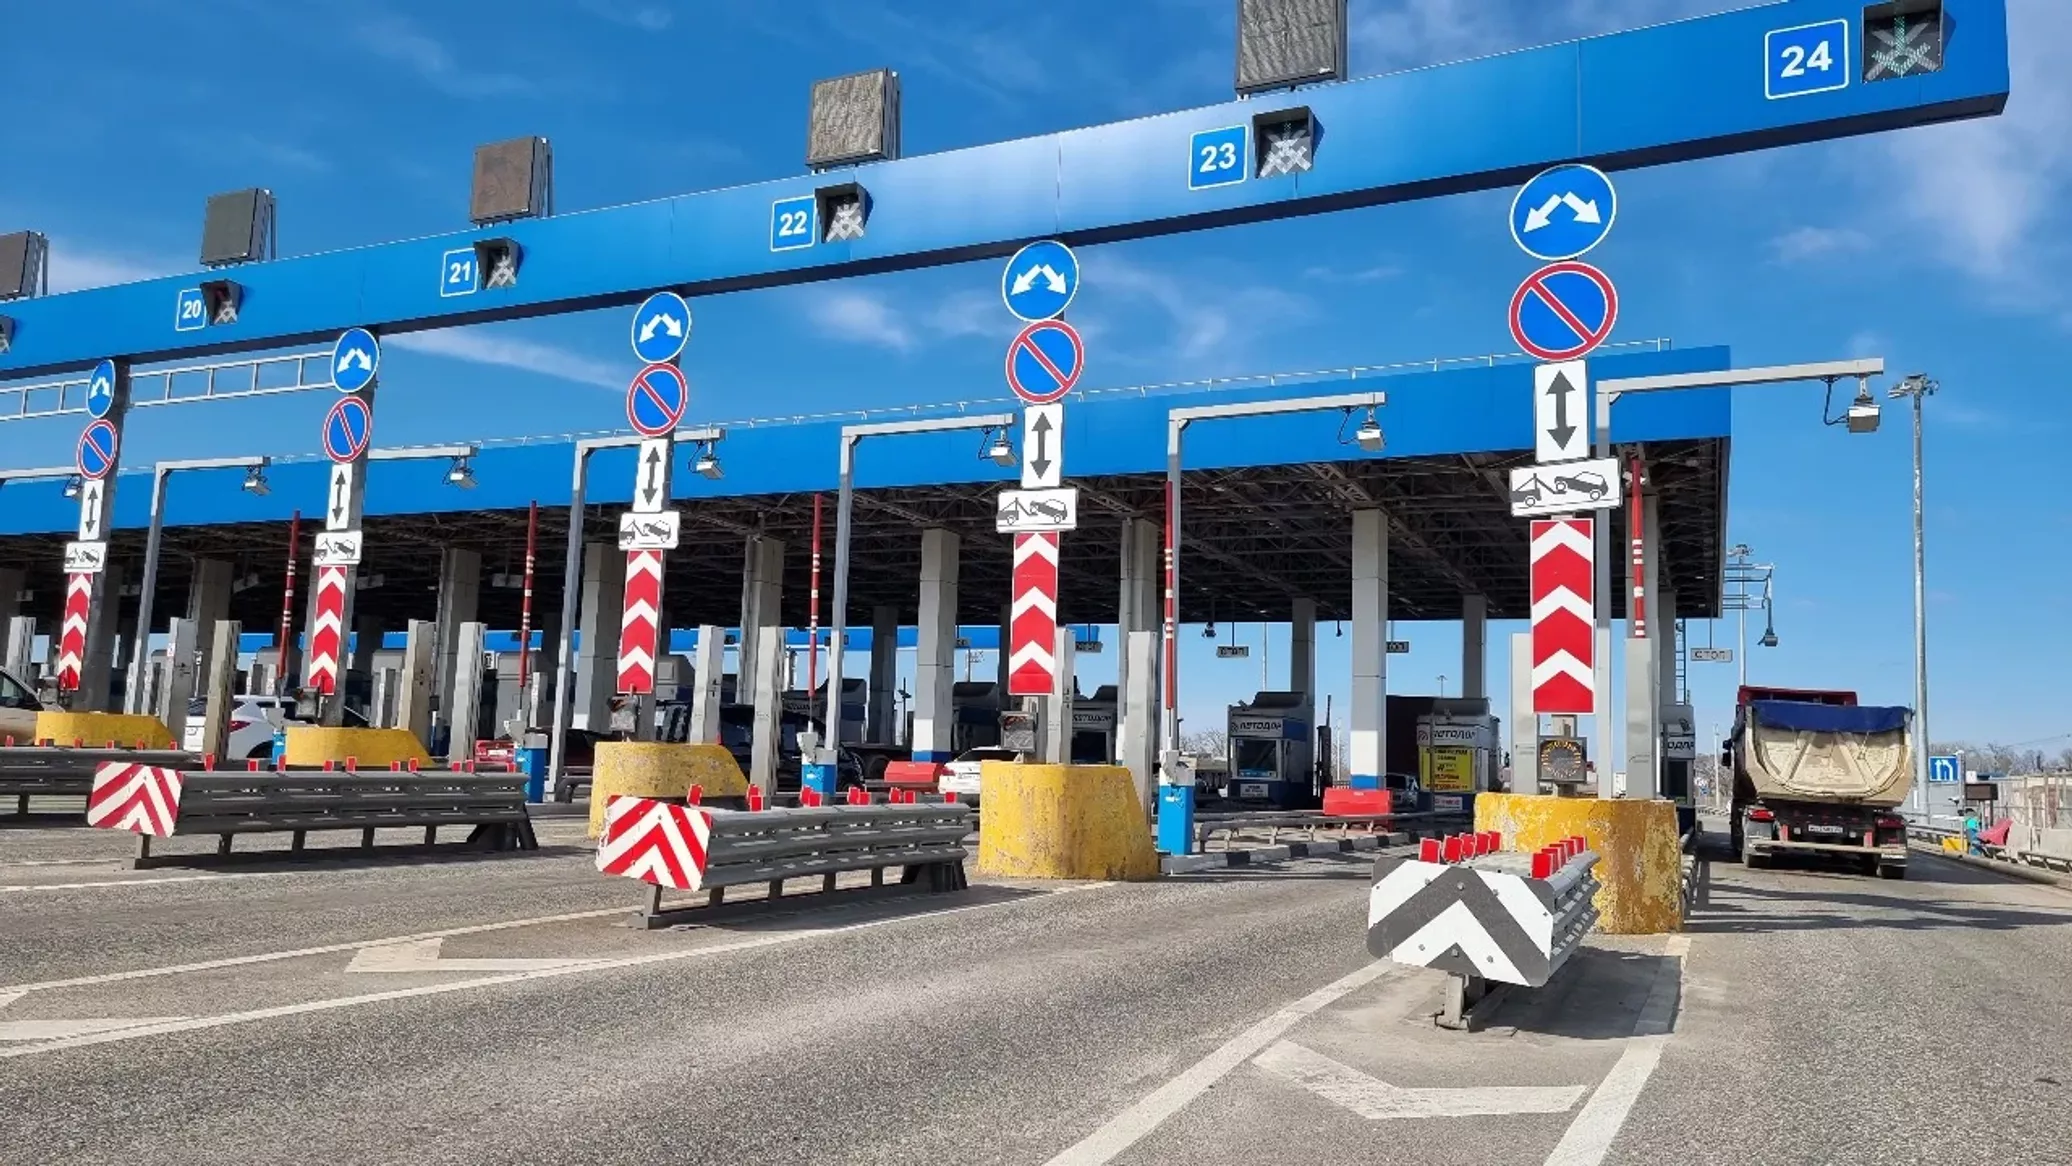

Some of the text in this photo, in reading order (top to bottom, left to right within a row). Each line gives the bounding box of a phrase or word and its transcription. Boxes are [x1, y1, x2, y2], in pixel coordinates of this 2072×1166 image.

[1780, 40, 1834, 78] 24
[1199, 142, 1237, 173] 23
[778, 210, 808, 237] 22
[448, 260, 471, 284] 21
[182, 299, 202, 319] 20
[1694, 650, 1725, 660] СТОП
